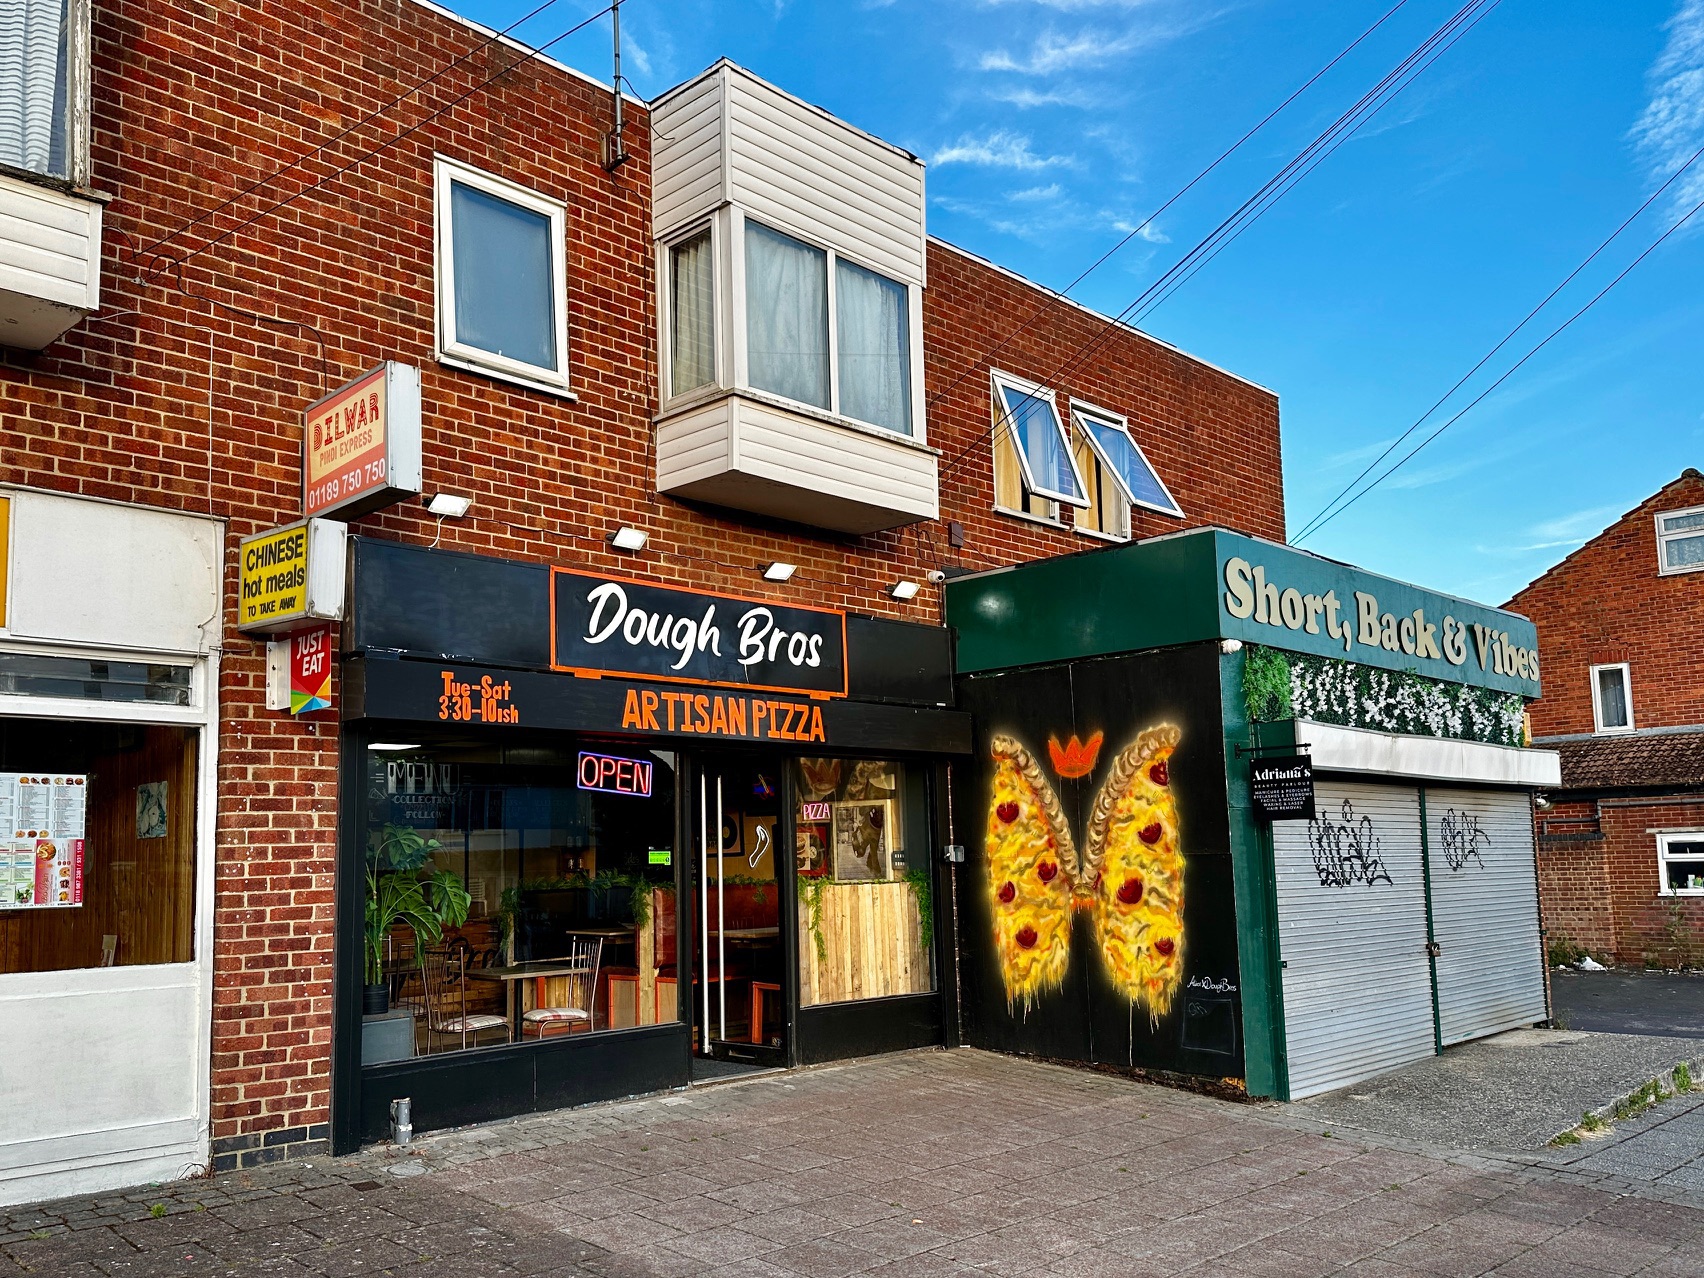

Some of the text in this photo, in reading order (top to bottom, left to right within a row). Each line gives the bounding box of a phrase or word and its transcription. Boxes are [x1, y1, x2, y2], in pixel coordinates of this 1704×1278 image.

[313, 392, 379, 452] DILWAR
[339, 428, 373, 458] EXPRESS
[309, 457, 386, 509] 01189 750 750
[246, 533, 304, 572] CHINESE
[243, 563, 305, 600] hot meals
[247, 595, 297, 618] TO TAKE AWAY
[1224, 557, 1540, 682] Short, Back & Vibes
[296, 629, 325, 660] JUST
[583, 582, 823, 671] Dough Bros
[302, 652, 325, 677] EAT
[441, 671, 512, 700] Tue-Sat
[621, 689, 826, 743] ARTISAN PIZZA
[387, 761, 460, 795] MENU
[580, 756, 650, 794] OPEN
[803, 803, 831, 820] PIZZA
